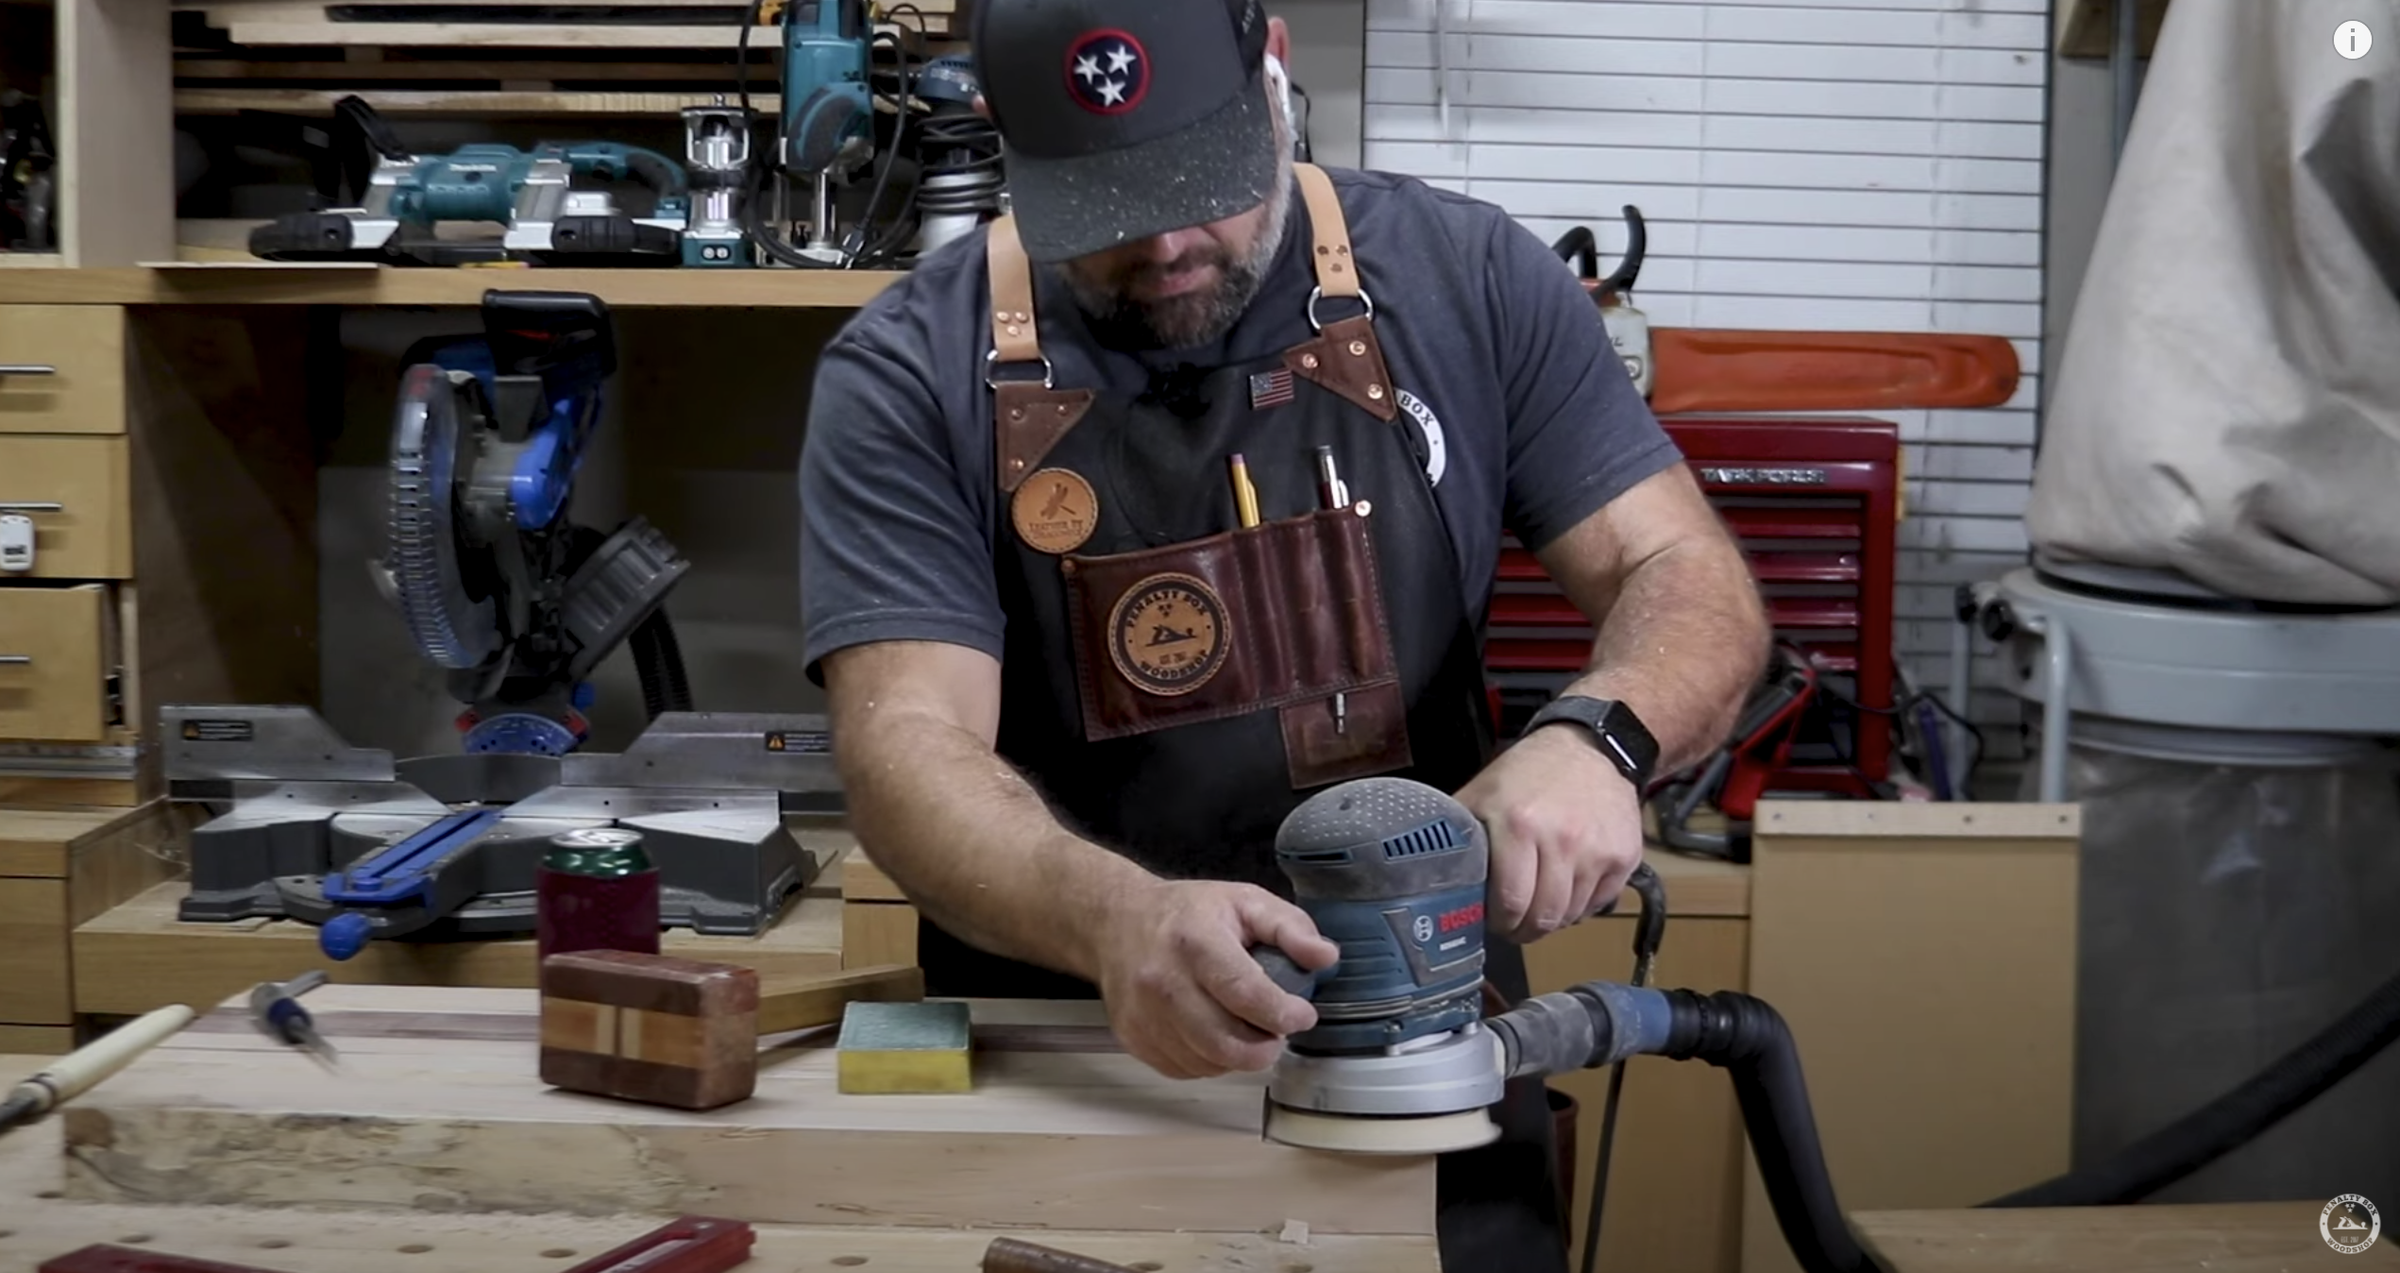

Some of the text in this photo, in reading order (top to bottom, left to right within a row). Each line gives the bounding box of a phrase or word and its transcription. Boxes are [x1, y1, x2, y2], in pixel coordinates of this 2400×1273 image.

[1400, 393, 1435, 428] BOX
[1127, 590, 1209, 628] PENALTY BOX
[1140, 649, 1208, 678] WOODSHOP
